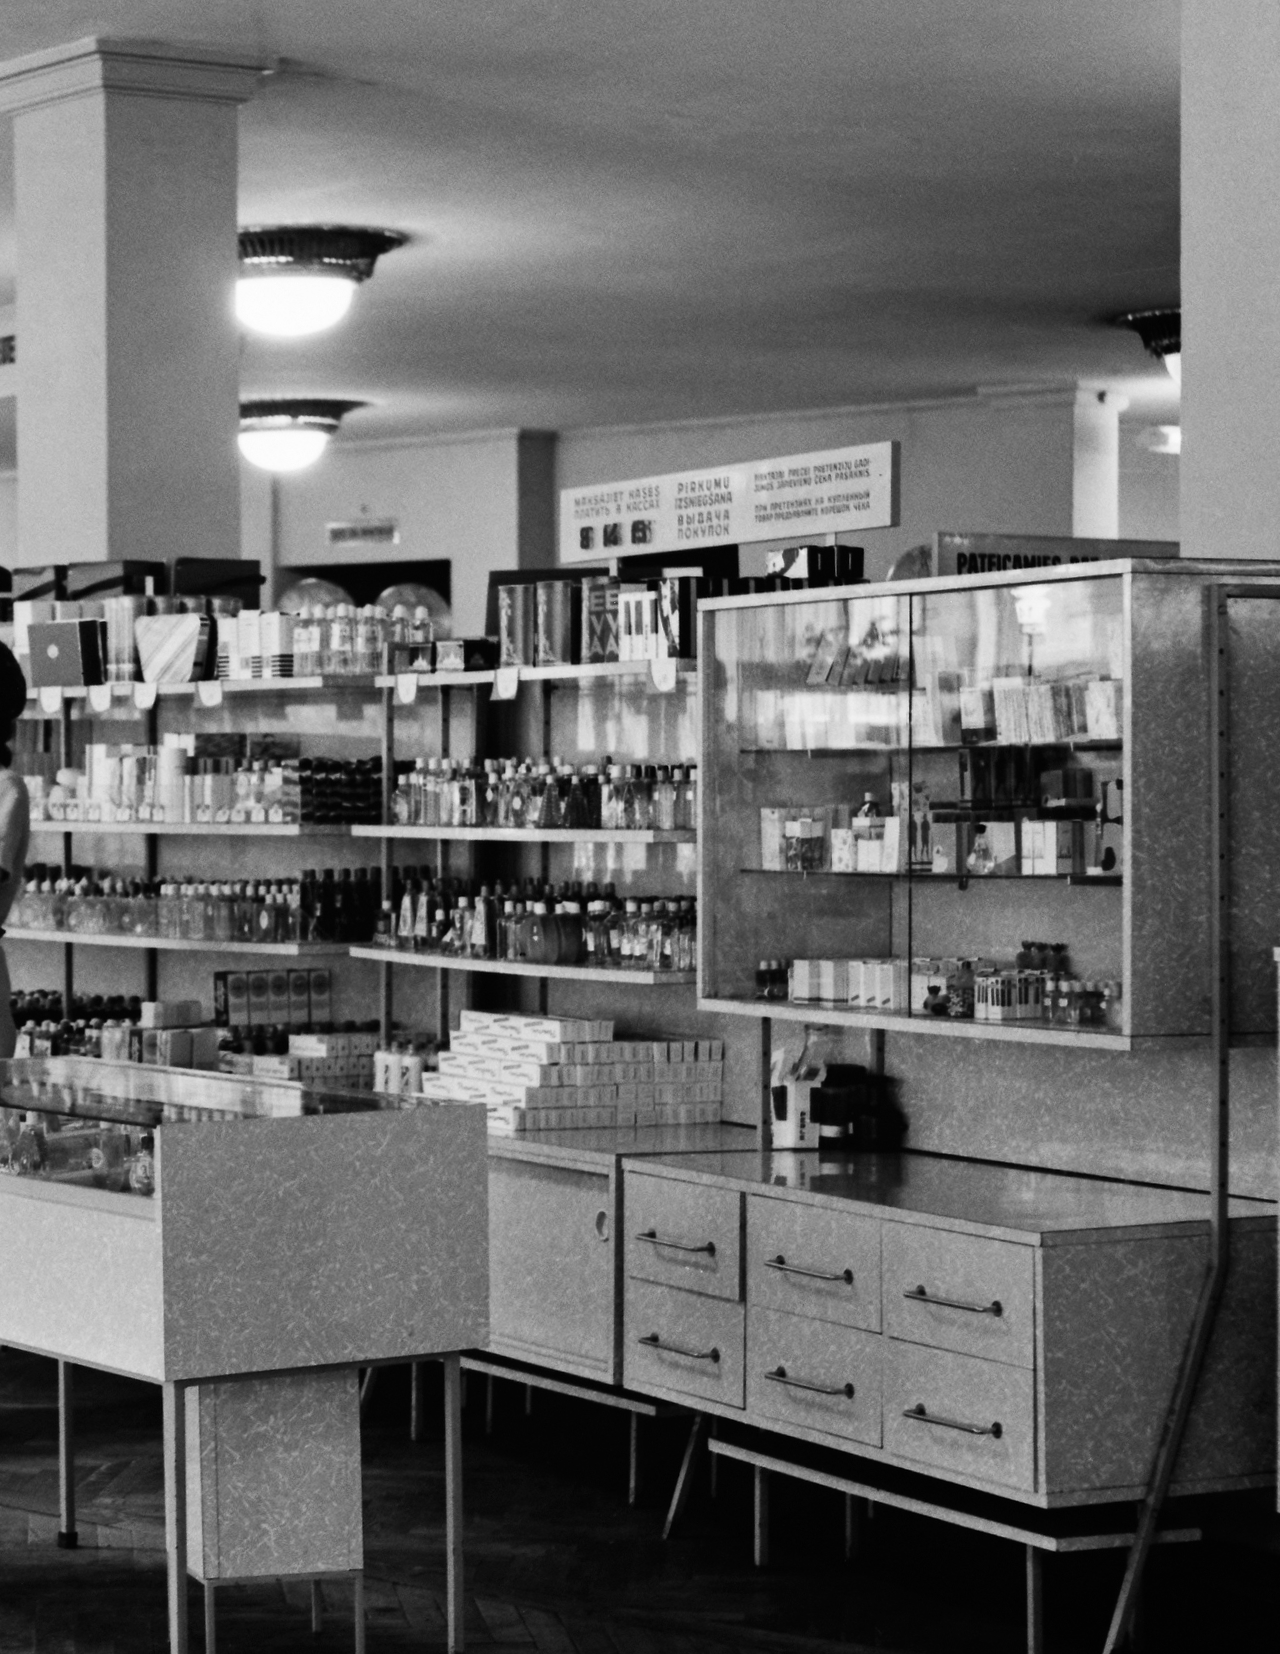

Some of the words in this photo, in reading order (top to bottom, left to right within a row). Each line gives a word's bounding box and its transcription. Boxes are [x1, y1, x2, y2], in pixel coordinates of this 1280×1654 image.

[677, 477, 730, 495] PIRKUMU
[674, 491, 733, 510] IZSNIEGŠANA
[677, 509, 730, 527] ВЫДАЧА
[677, 523, 730, 539] ПОКУПОК
